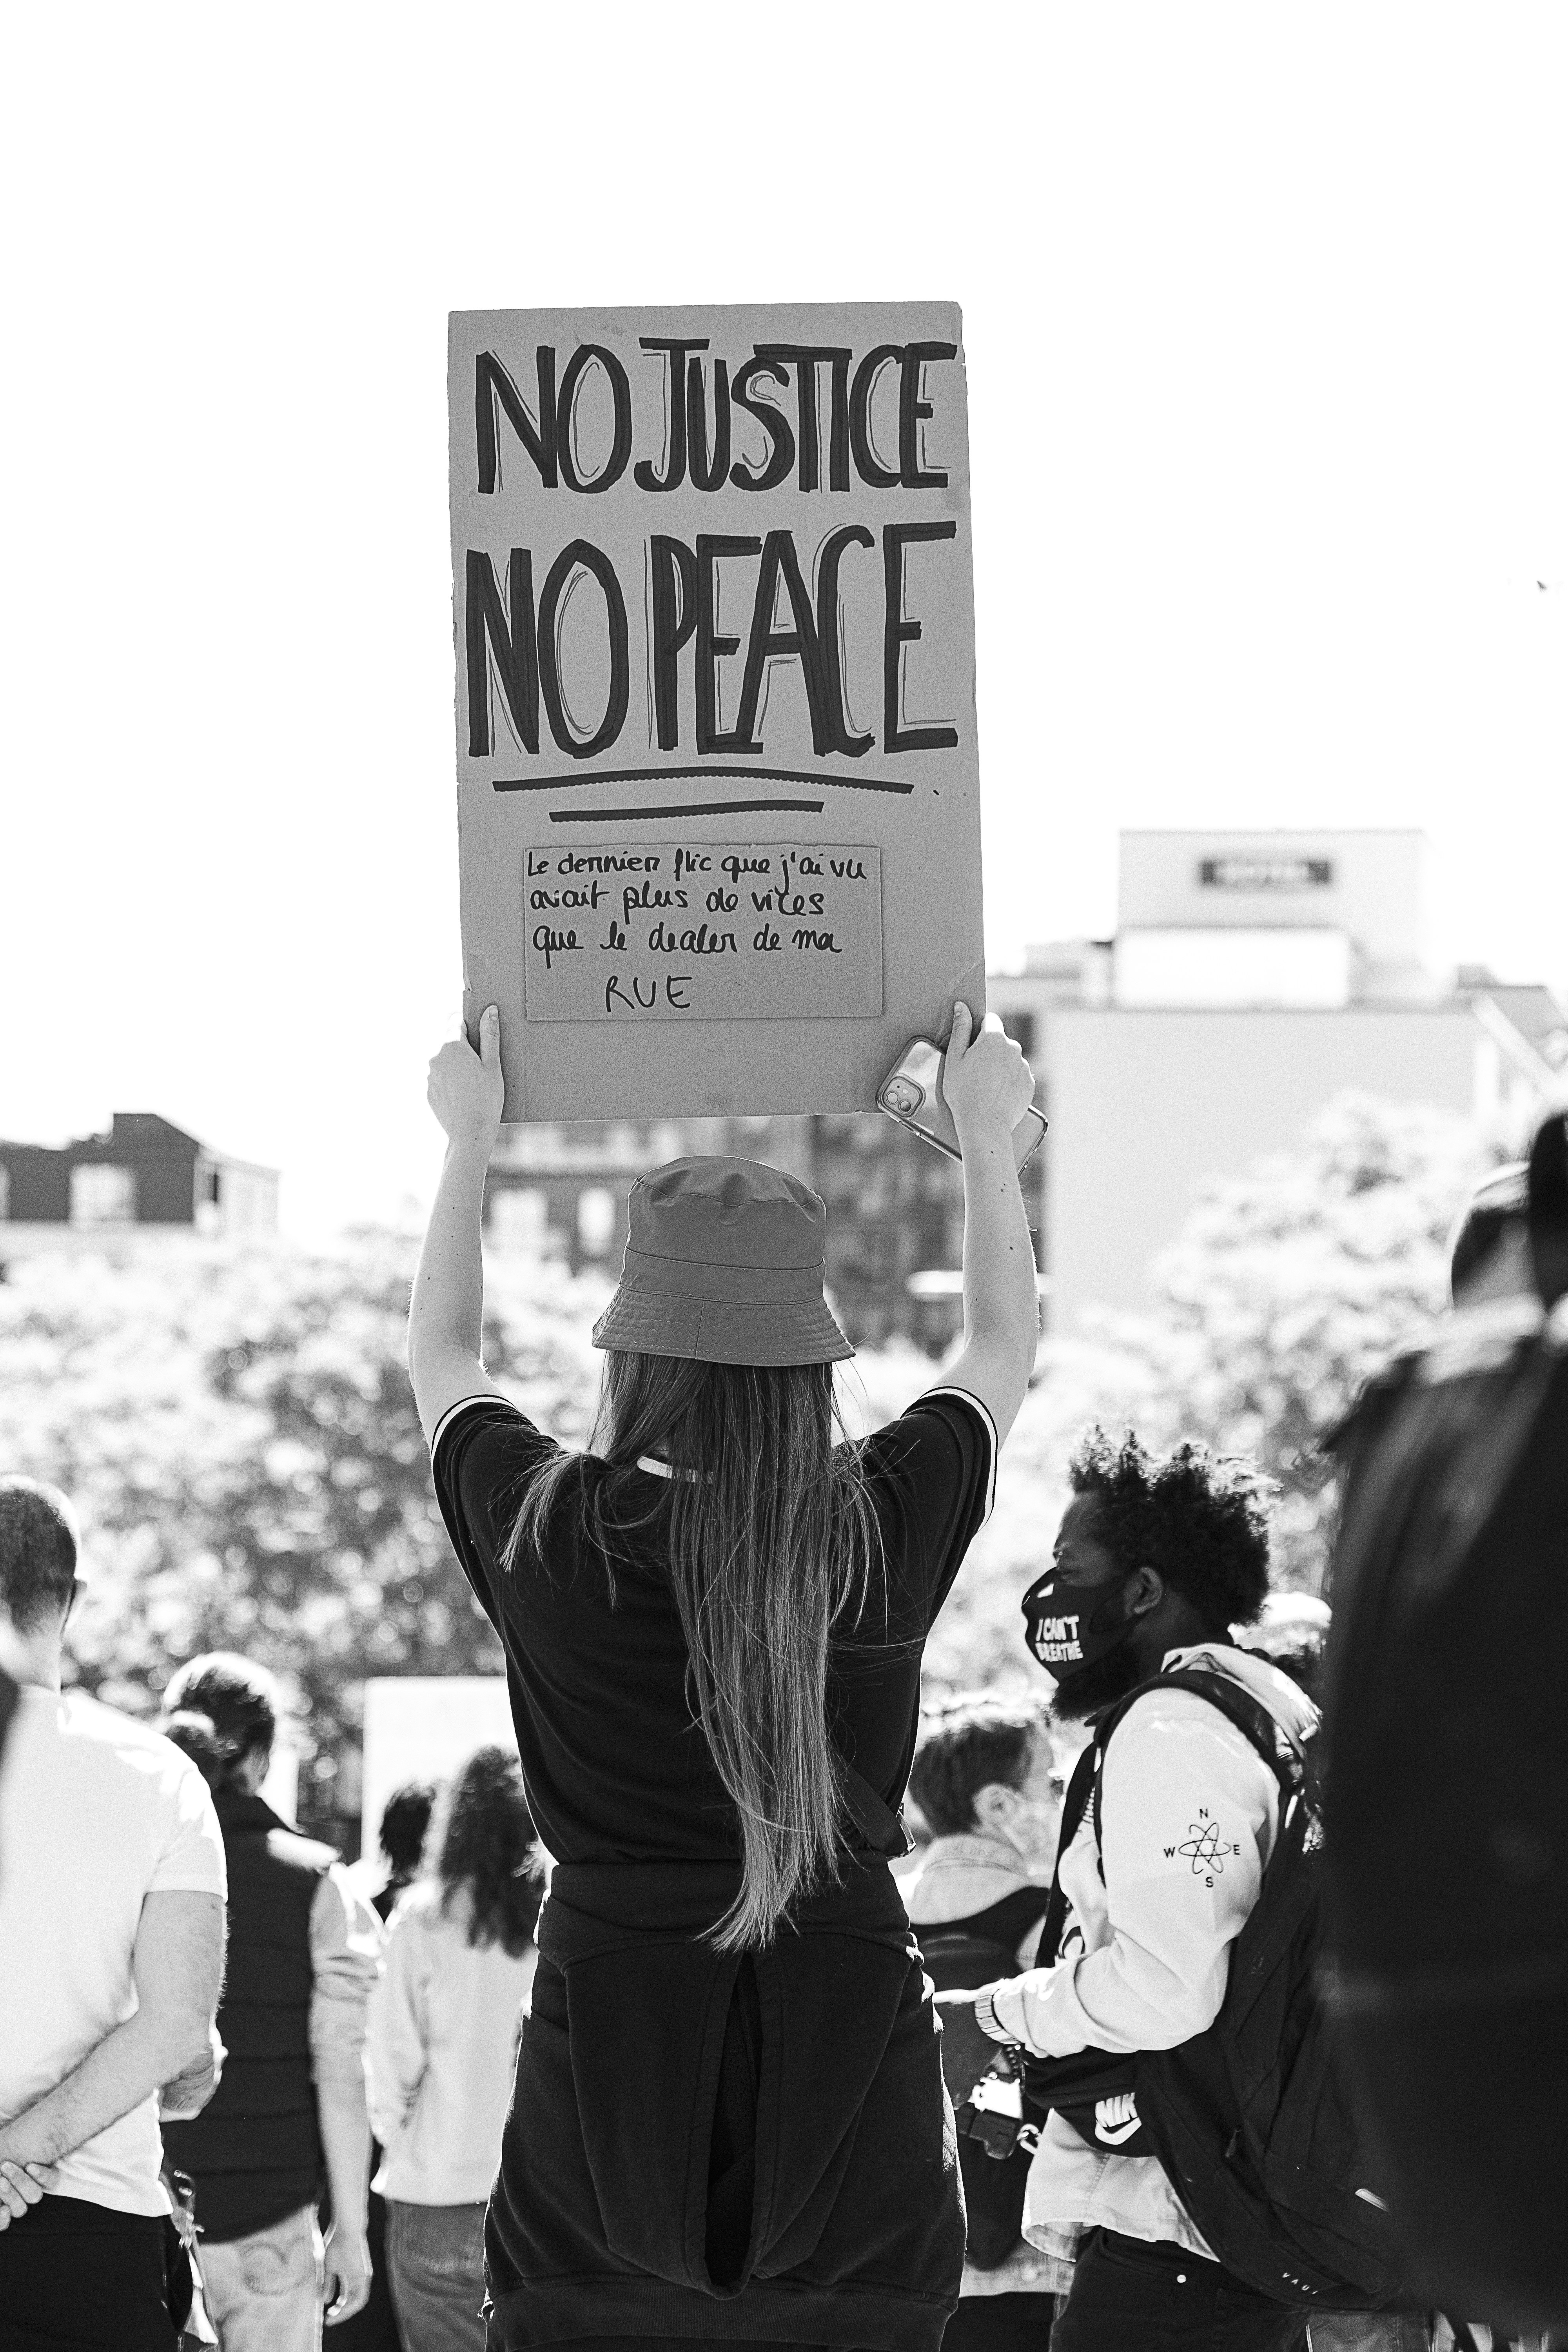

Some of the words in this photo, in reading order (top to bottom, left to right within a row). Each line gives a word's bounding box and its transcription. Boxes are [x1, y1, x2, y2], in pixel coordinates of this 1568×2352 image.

[475, 343, 632, 494] NO
[634, 337, 958, 493] JUSTICE
[466, 539, 630, 759] NO
[643, 521, 959, 758] PEACE
[528, 851, 549, 877] Le
[557, 852, 661, 875] dernier
[674, 848, 712, 882] flic
[721, 855, 770, 884] que
[780, 851, 824, 895] j'ai
[829, 858, 867, 880] vu
[530, 880, 610, 910] avait
[623, 880, 688, 925] plus
[706, 887, 739, 913] de
[533, 925, 584, 969] que
[600, 921, 628, 951] le
[648, 922, 738, 954] dealer
[753, 923, 782, 951] de
[791, 929, 842, 954] ma
[606, 975, 692, 1013] RUE
[1036, 1618, 1044, 1641] I
[1199, 1808, 1209, 1818] N
[1163, 1847, 1175, 1858] W
[1233, 1844, 1241, 1855] E
[1205, 1876, 1214, 1888] S
[1282, 2272, 1318, 2294] VAU
